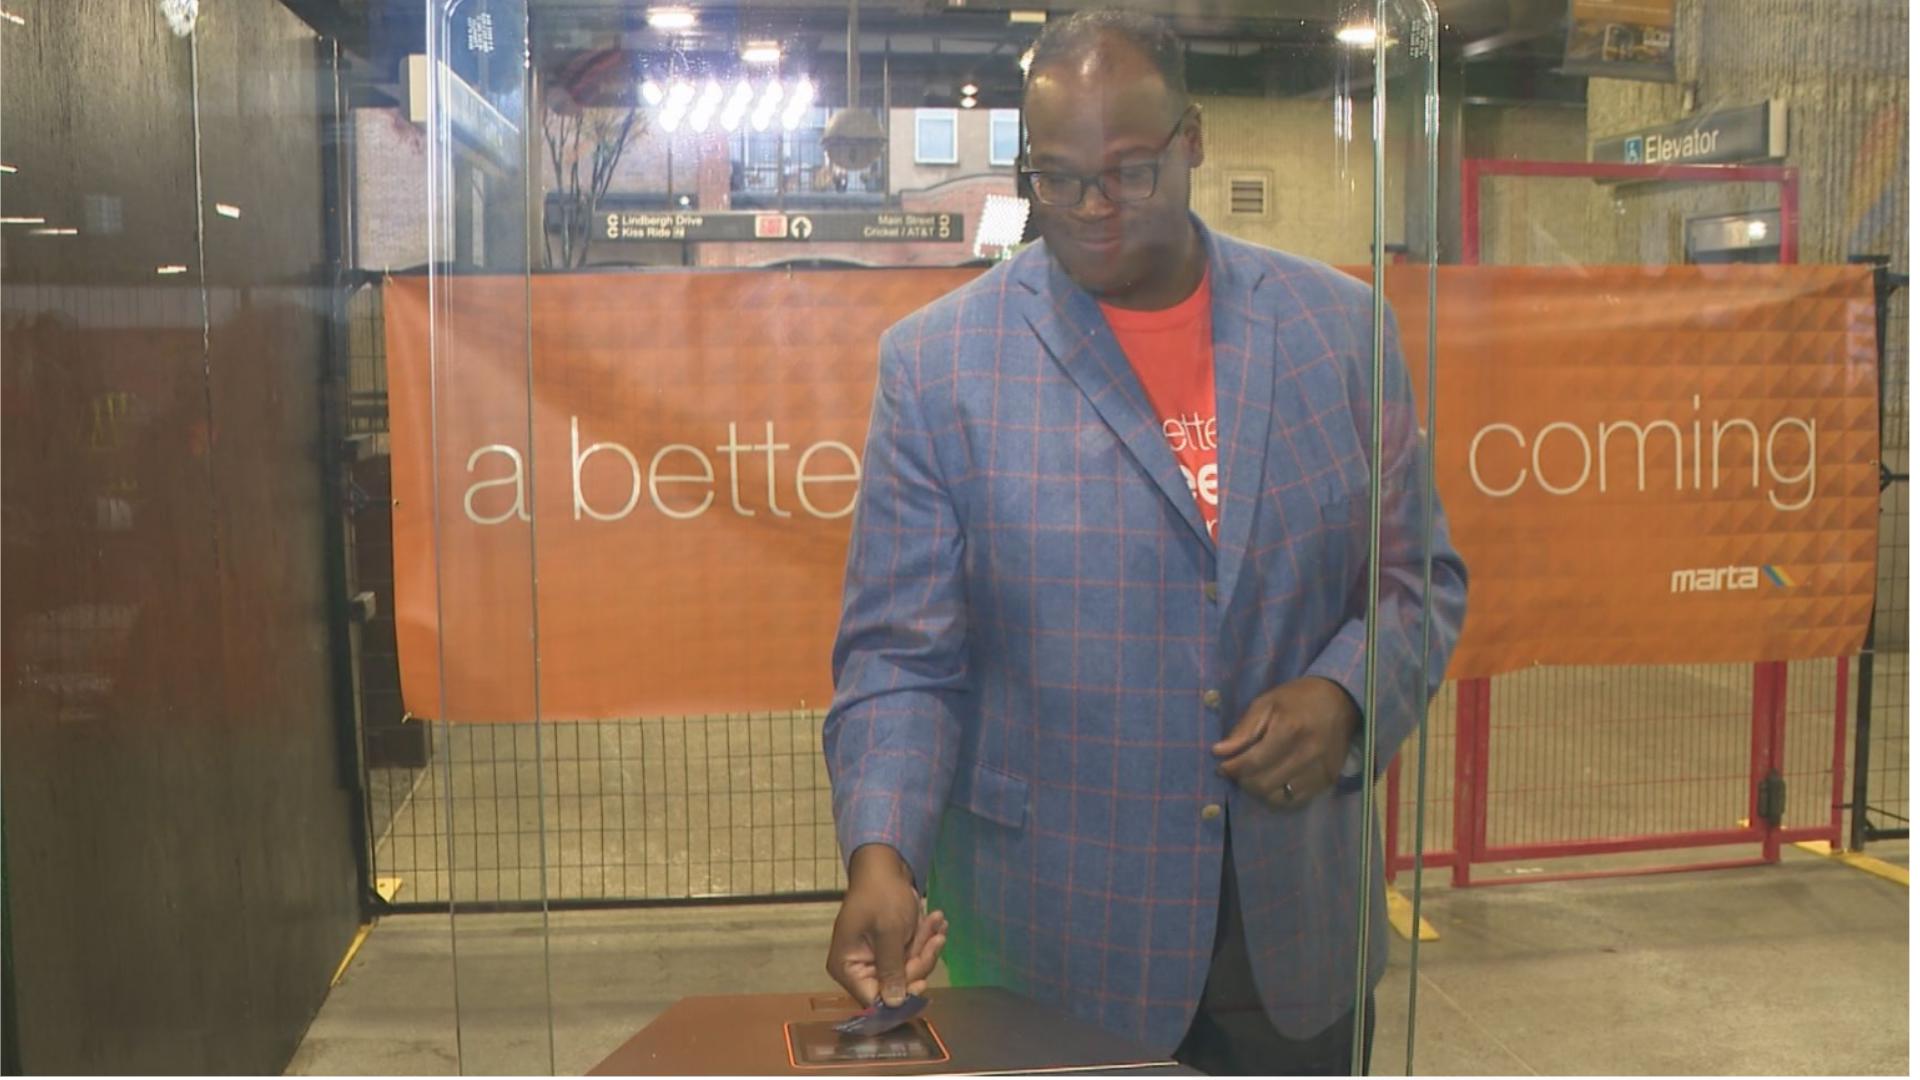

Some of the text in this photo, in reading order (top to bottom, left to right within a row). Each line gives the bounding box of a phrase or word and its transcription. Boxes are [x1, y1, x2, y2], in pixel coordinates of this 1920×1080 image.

[1645, 129, 1719, 164] Elevator
[622, 214, 703, 227] Lindbergh Drive
[878, 214, 935, 225] Main Street
[622, 227, 671, 237] Kiss Ride
[906, 227, 935, 237] AT&T
[464, 394, 1816, 525] a bette coming
[1671, 565, 1759, 593] marta
